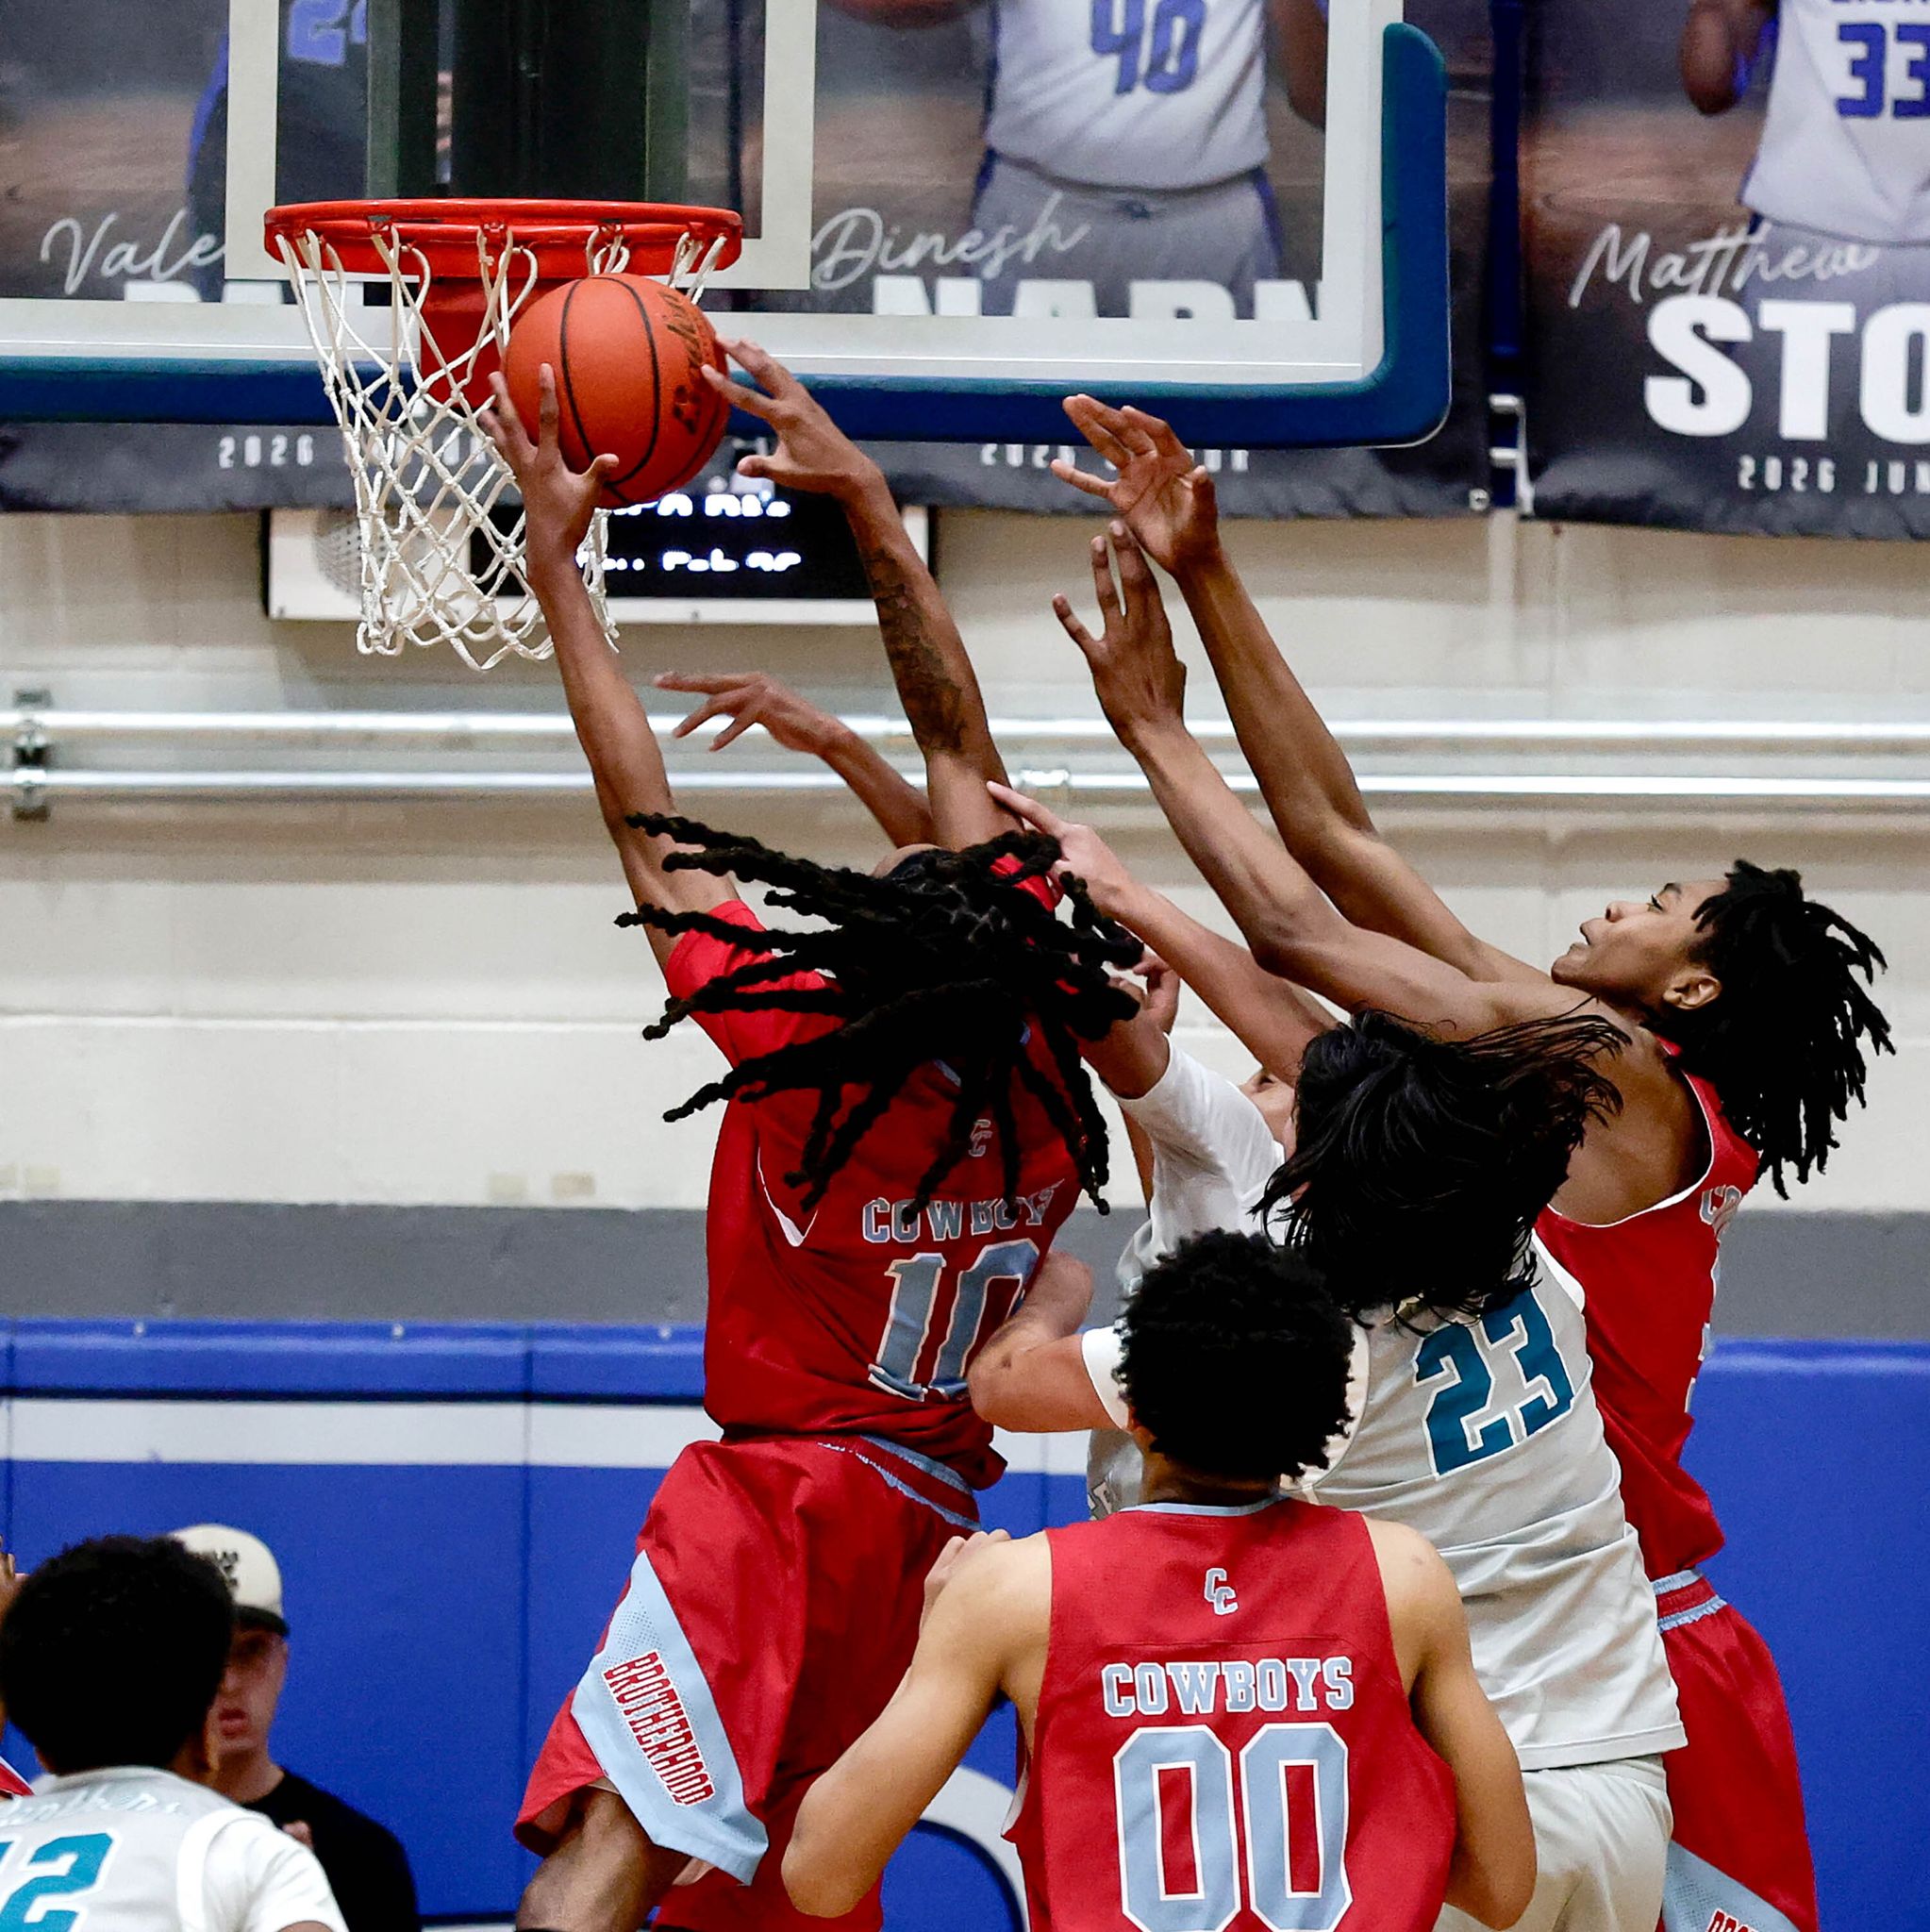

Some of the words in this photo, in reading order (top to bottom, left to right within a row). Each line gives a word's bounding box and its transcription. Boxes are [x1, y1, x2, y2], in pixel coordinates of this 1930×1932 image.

[1091, 0, 1206, 94] 40
[1836, 23, 1930, 118] 33
[811, 192, 1091, 290] Dinesh
[1568, 224, 1880, 308] Matthew
[1644, 293, 1930, 445] STO
[218, 435, 313, 469] 2026
[1738, 454, 1836, 493] 2026
[862, 1184, 1057, 1243] COWBOY
[868, 1238, 1040, 1402] 10
[1413, 1280, 1575, 1479] 23
[1204, 1567, 1239, 1615] CC
[601, 1649, 716, 1807] BROTHERHOOD
[1101, 1656, 1354, 1717] COWBOYS
[1112, 1722, 1353, 1932] 00
